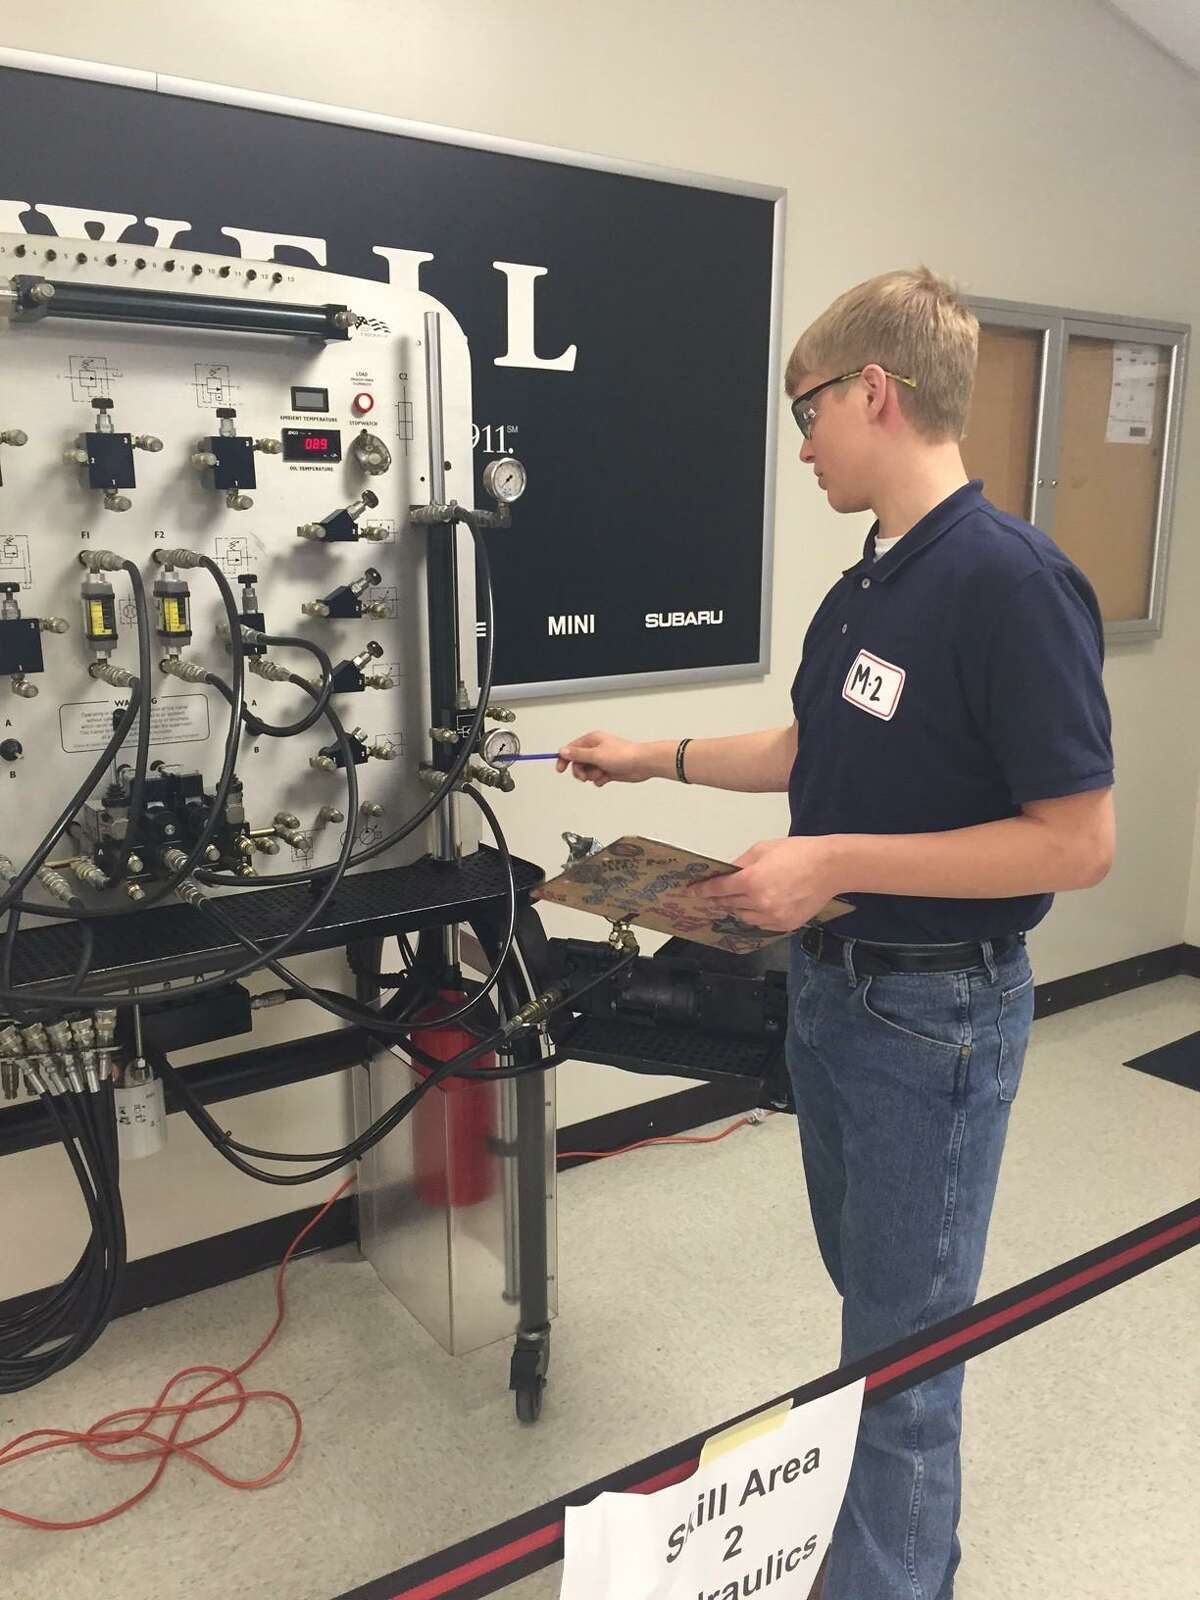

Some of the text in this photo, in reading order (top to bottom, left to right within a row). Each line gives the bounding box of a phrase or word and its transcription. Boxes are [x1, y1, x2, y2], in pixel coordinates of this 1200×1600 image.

[398, 372, 409, 380] C2
[304, 438, 328, 450] 089
[81, 530, 90, 539] F1
[154, 530, 165, 539] F2
[548, 610, 723, 636] MINI SUBARU
[5, 719, 12, 727] A
[9, 770, 17, 778] B
[739, 1447, 820, 1507] Area
[722, 1525, 744, 1562] 2
[697, 1534, 818, 1600] aulics
